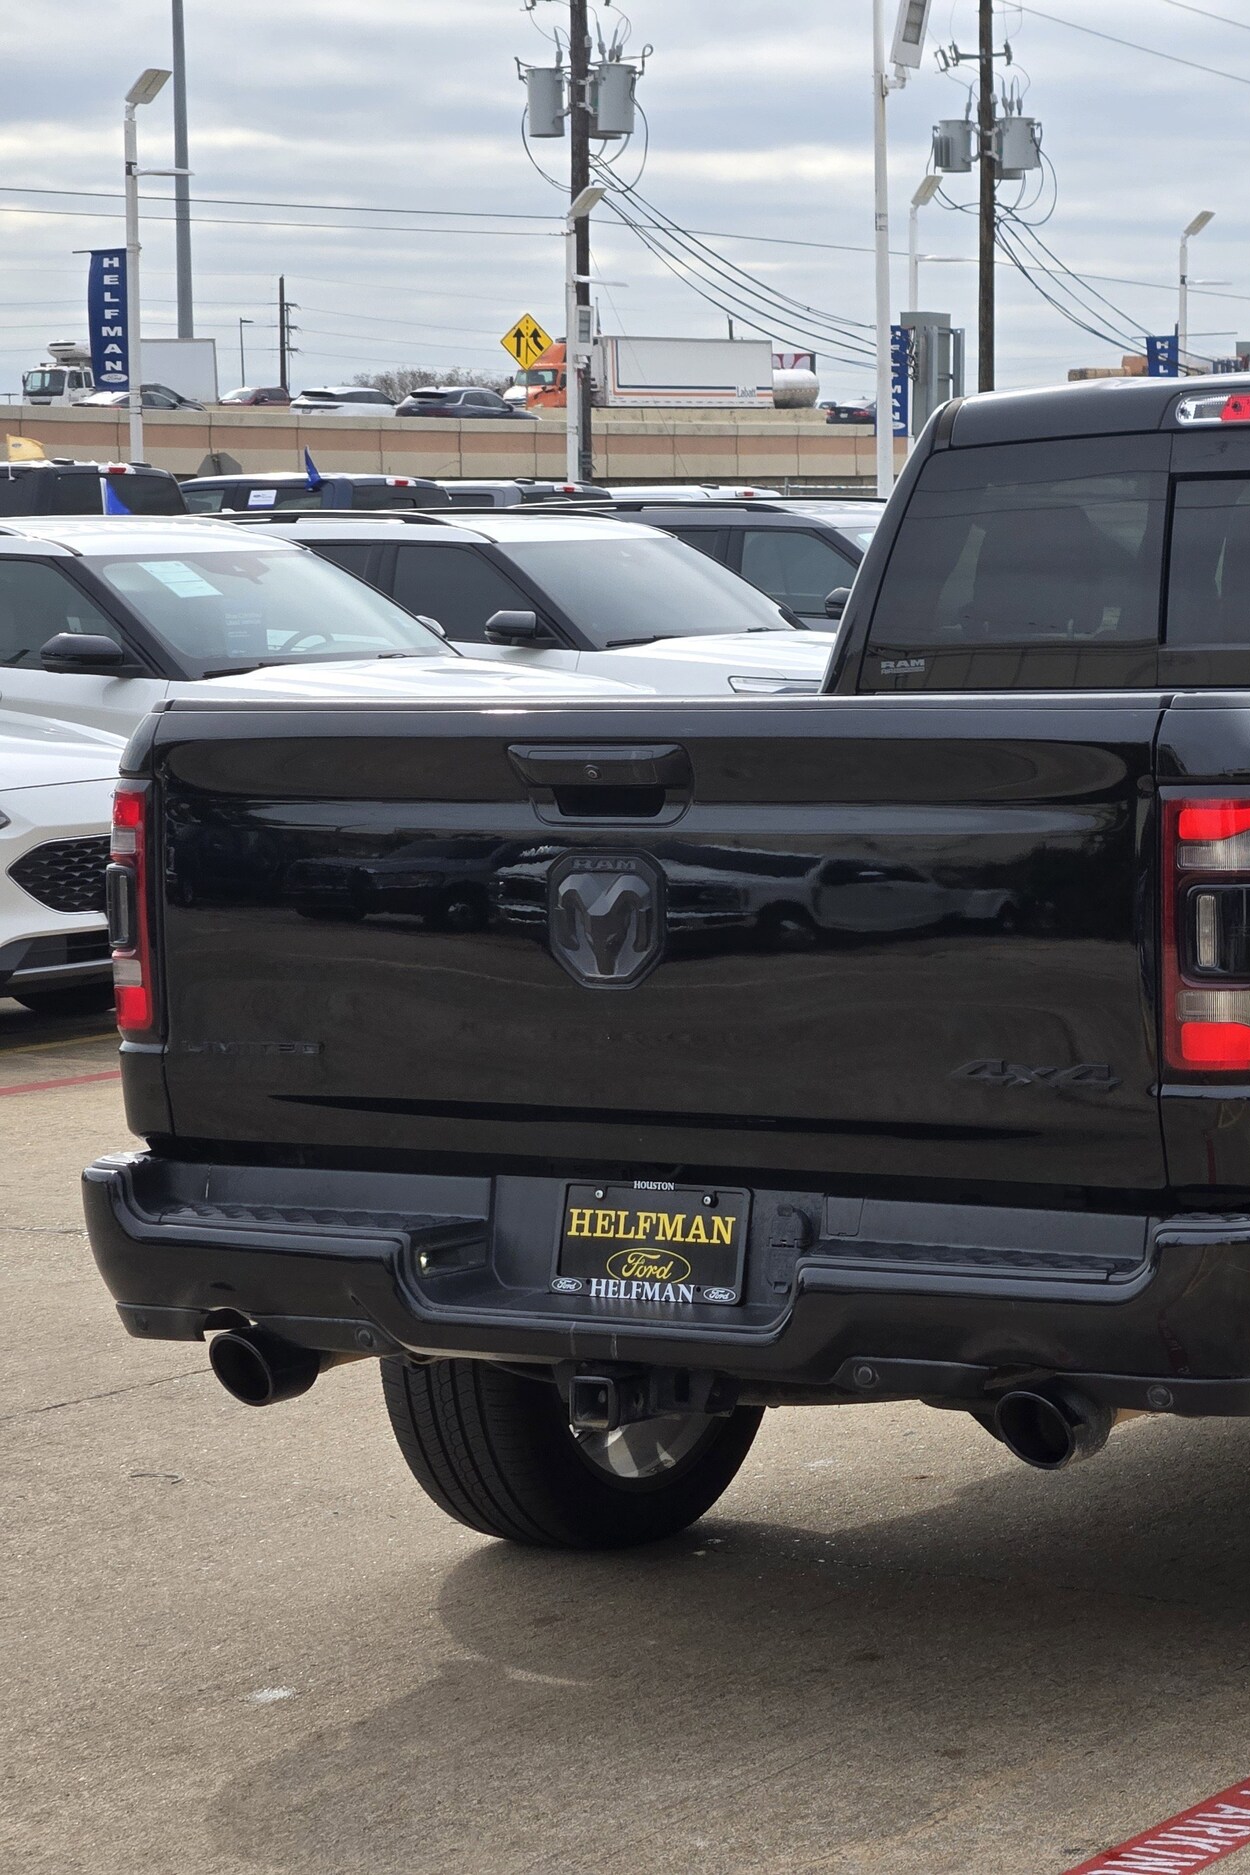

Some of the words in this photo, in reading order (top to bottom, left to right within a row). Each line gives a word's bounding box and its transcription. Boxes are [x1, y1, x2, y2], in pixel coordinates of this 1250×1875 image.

[102, 257, 123, 372] HELFMAN
[880, 659, 925, 668] RAM
[572, 859, 637, 870] RAM
[633, 1180, 675, 1191] HOUSTON
[567, 1208, 736, 1245] HELFMAN
[621, 1251, 674, 1280] Ford
[589, 1278, 696, 1304] HELFMAN
